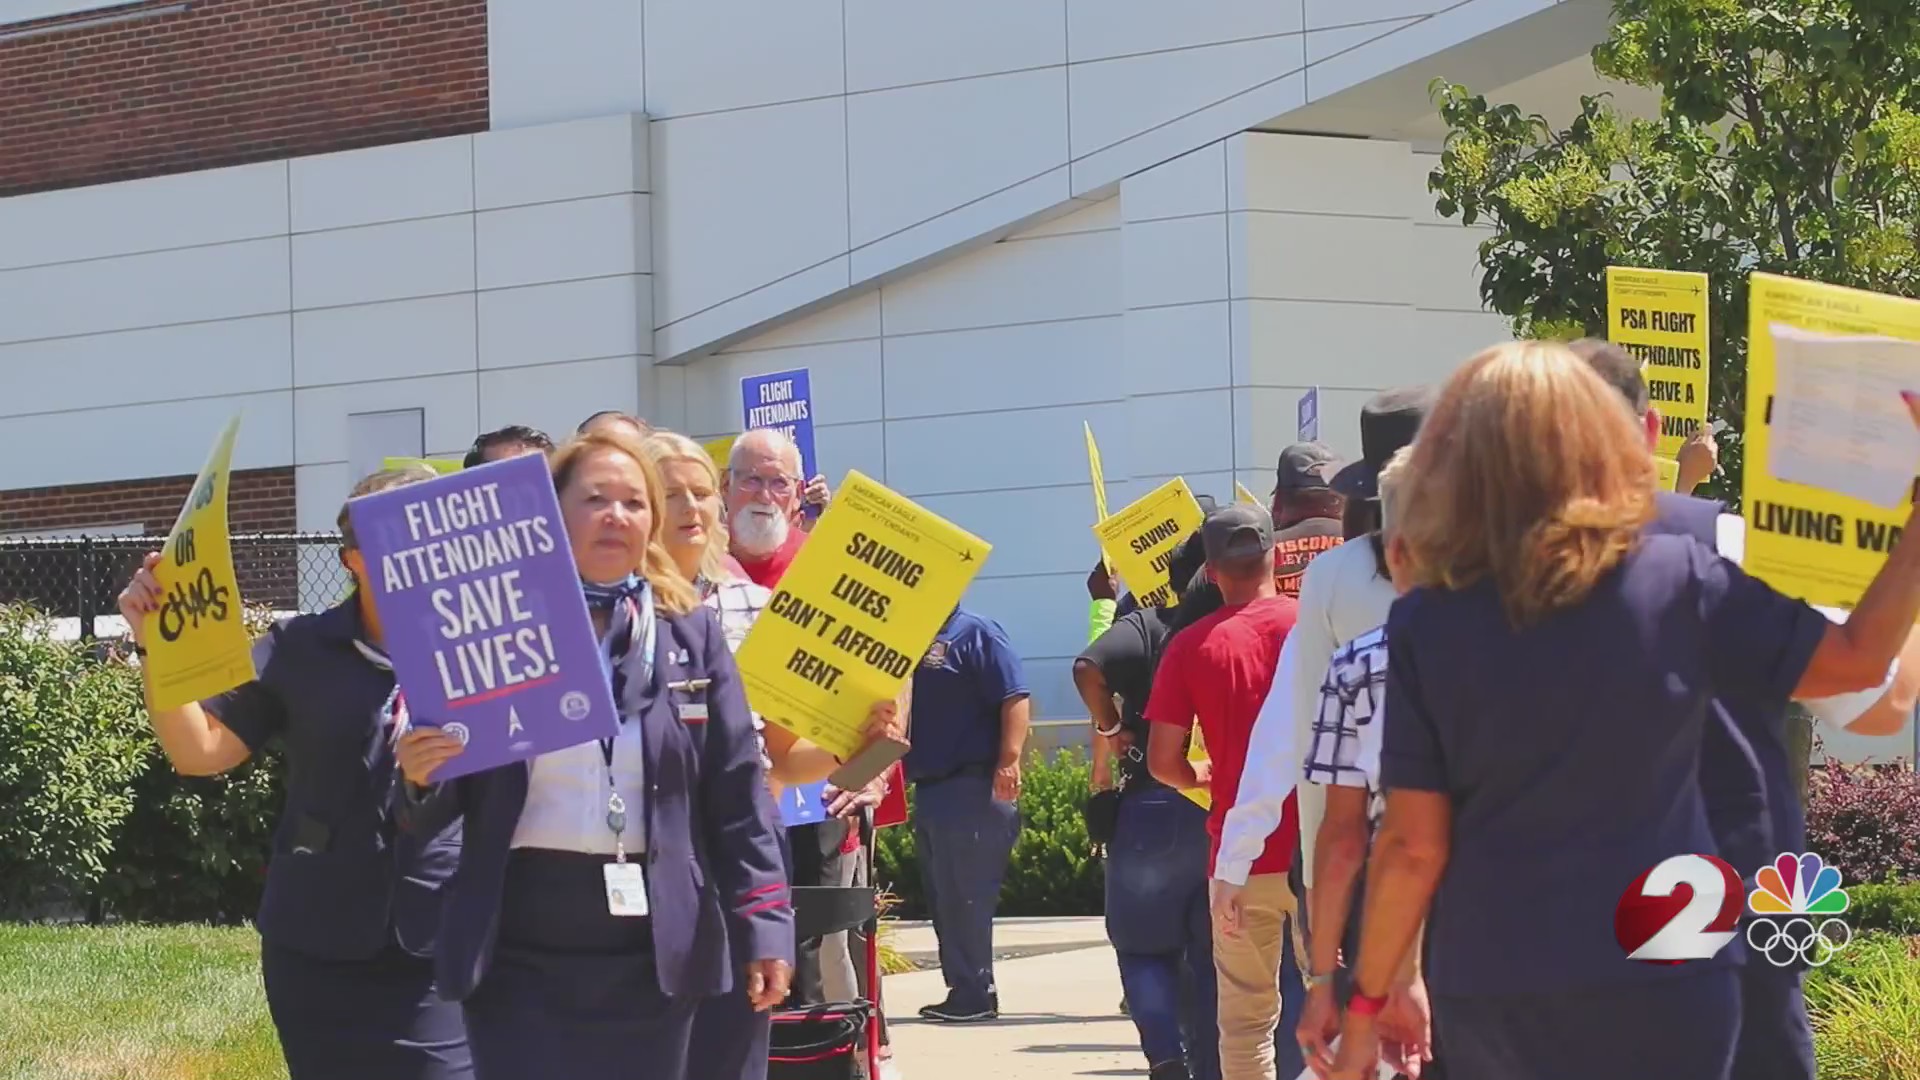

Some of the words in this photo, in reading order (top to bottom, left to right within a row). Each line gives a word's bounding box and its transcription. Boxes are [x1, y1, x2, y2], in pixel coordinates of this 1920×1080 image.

[1620, 307, 1647, 330] PSA
[1651, 310, 1697, 333] FLIGHT
[749, 399, 809, 430] ATTENDANTS
[760, 379, 793, 404] FLIGHT
[1685, 382, 1695, 404] A
[404, 482, 503, 541] FLIGHT
[1753, 500, 1843, 545] LIVING
[175, 528, 196, 567] OR
[382, 516, 555, 594] ATTENDANTS
[846, 531, 925, 589] SAVING
[1130, 518, 1179, 555] SAVING
[159, 567, 230, 643] CHAOS
[431, 570, 534, 640] SAVE
[830, 573, 892, 623] LIVES.
[769, 590, 837, 638] CAN'T
[832, 624, 913, 681] AFFORD
[434, 623, 560, 701] LIVES!
[786, 647, 844, 695] RENT.
